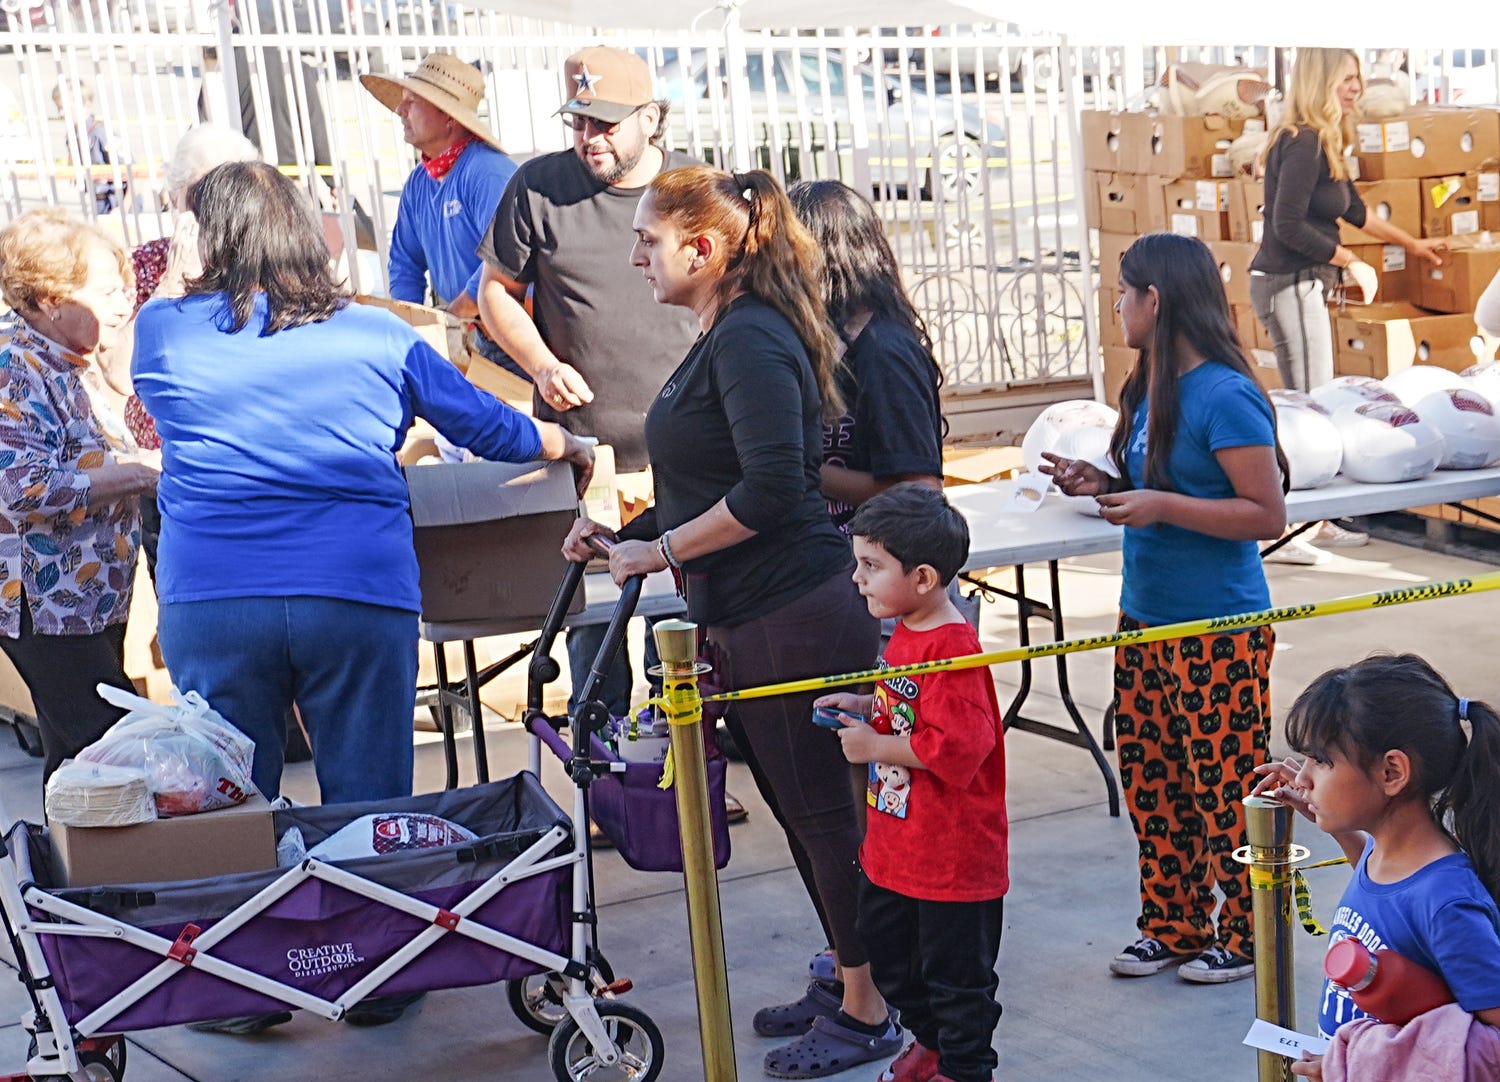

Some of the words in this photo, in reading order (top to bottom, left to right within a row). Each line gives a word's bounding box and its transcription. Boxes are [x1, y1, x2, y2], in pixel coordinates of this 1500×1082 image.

[287, 943, 354, 960] CREATIVE
[289, 953, 358, 971] OUTDOOR
[1279, 1037, 1300, 1048] 173
